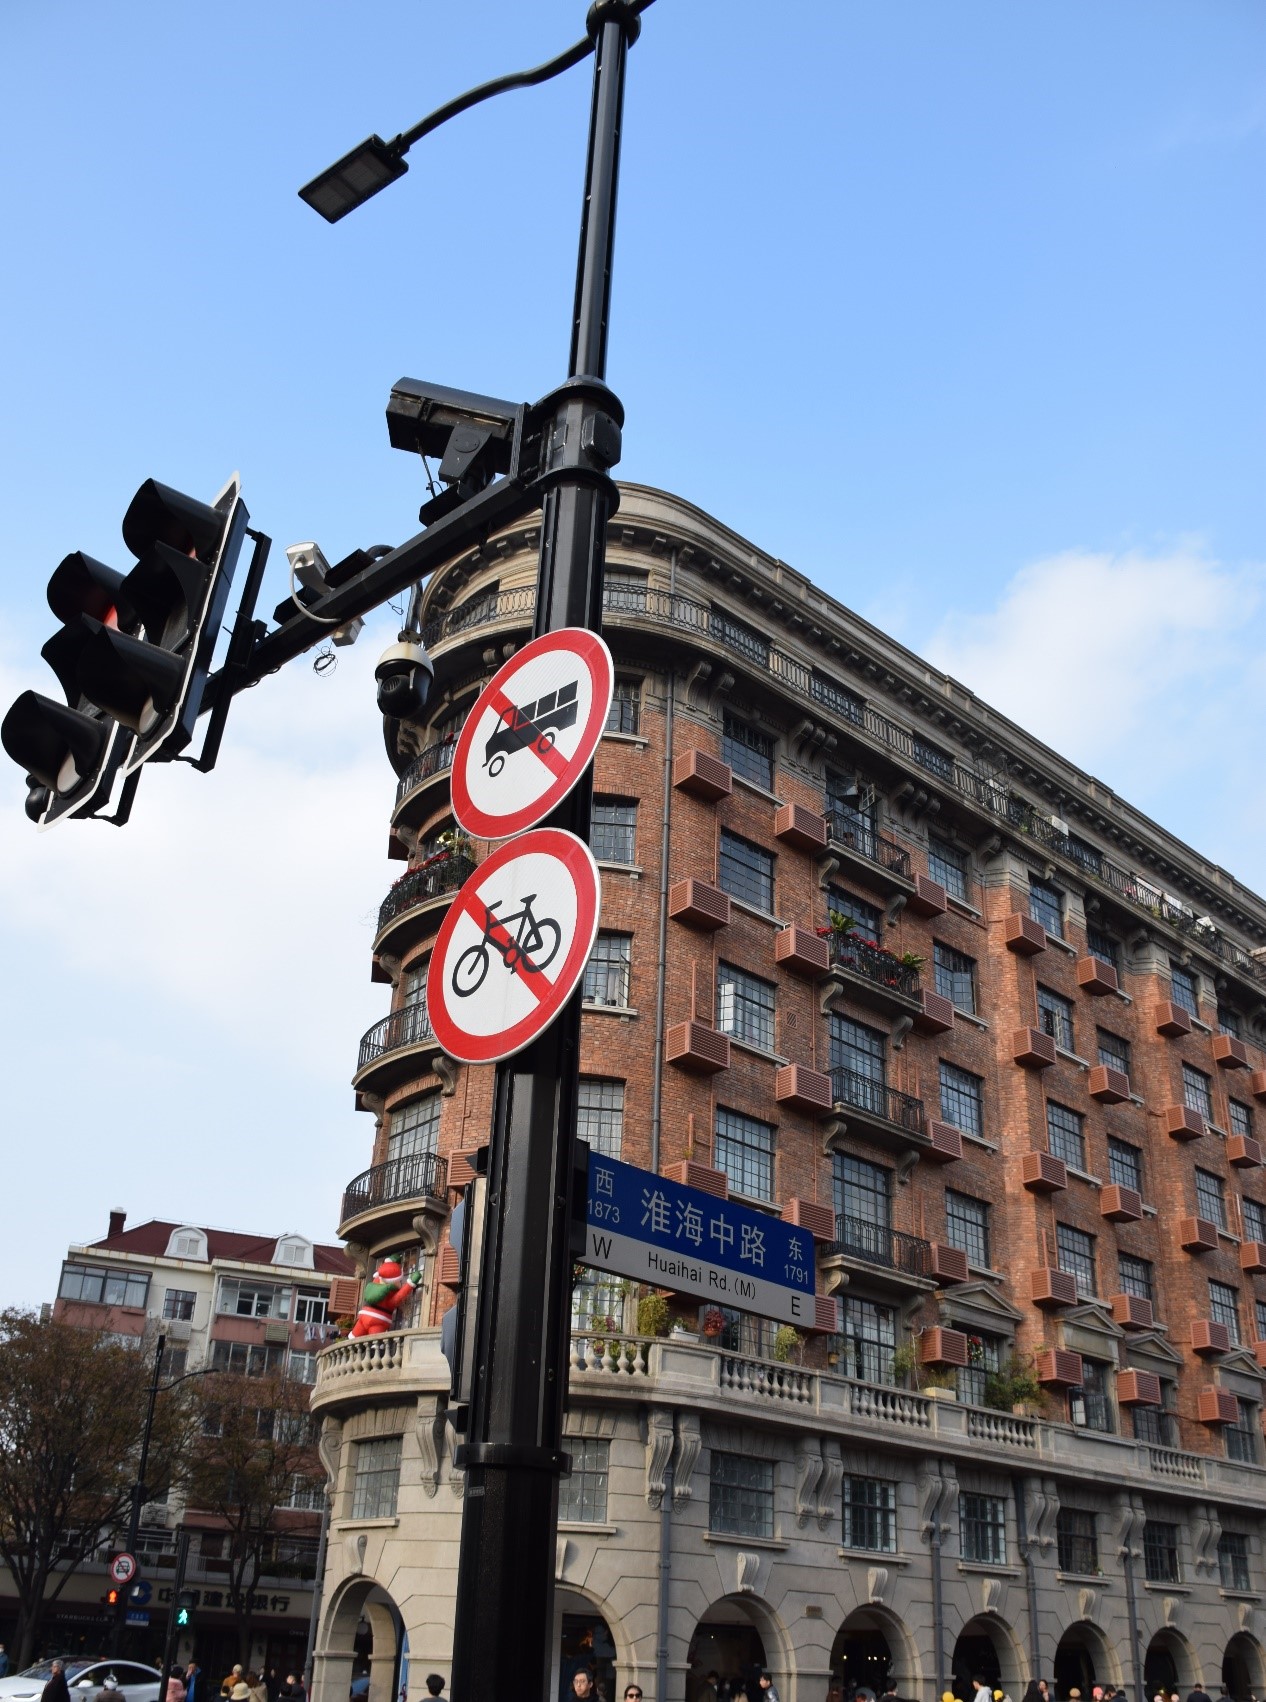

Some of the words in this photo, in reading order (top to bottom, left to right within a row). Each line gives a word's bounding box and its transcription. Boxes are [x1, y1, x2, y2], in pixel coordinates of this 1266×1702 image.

[595, 1167, 615, 1198] 西
[587, 1199, 620, 1224] 1873
[640, 1188, 766, 1267] 淮海中路
[592, 1233, 613, 1260] W
[788, 1236, 803, 1261] 东
[648, 1251, 702, 1283] Huaihai
[784, 1264, 809, 1285] 1791
[791, 1295, 801, 1317] E
